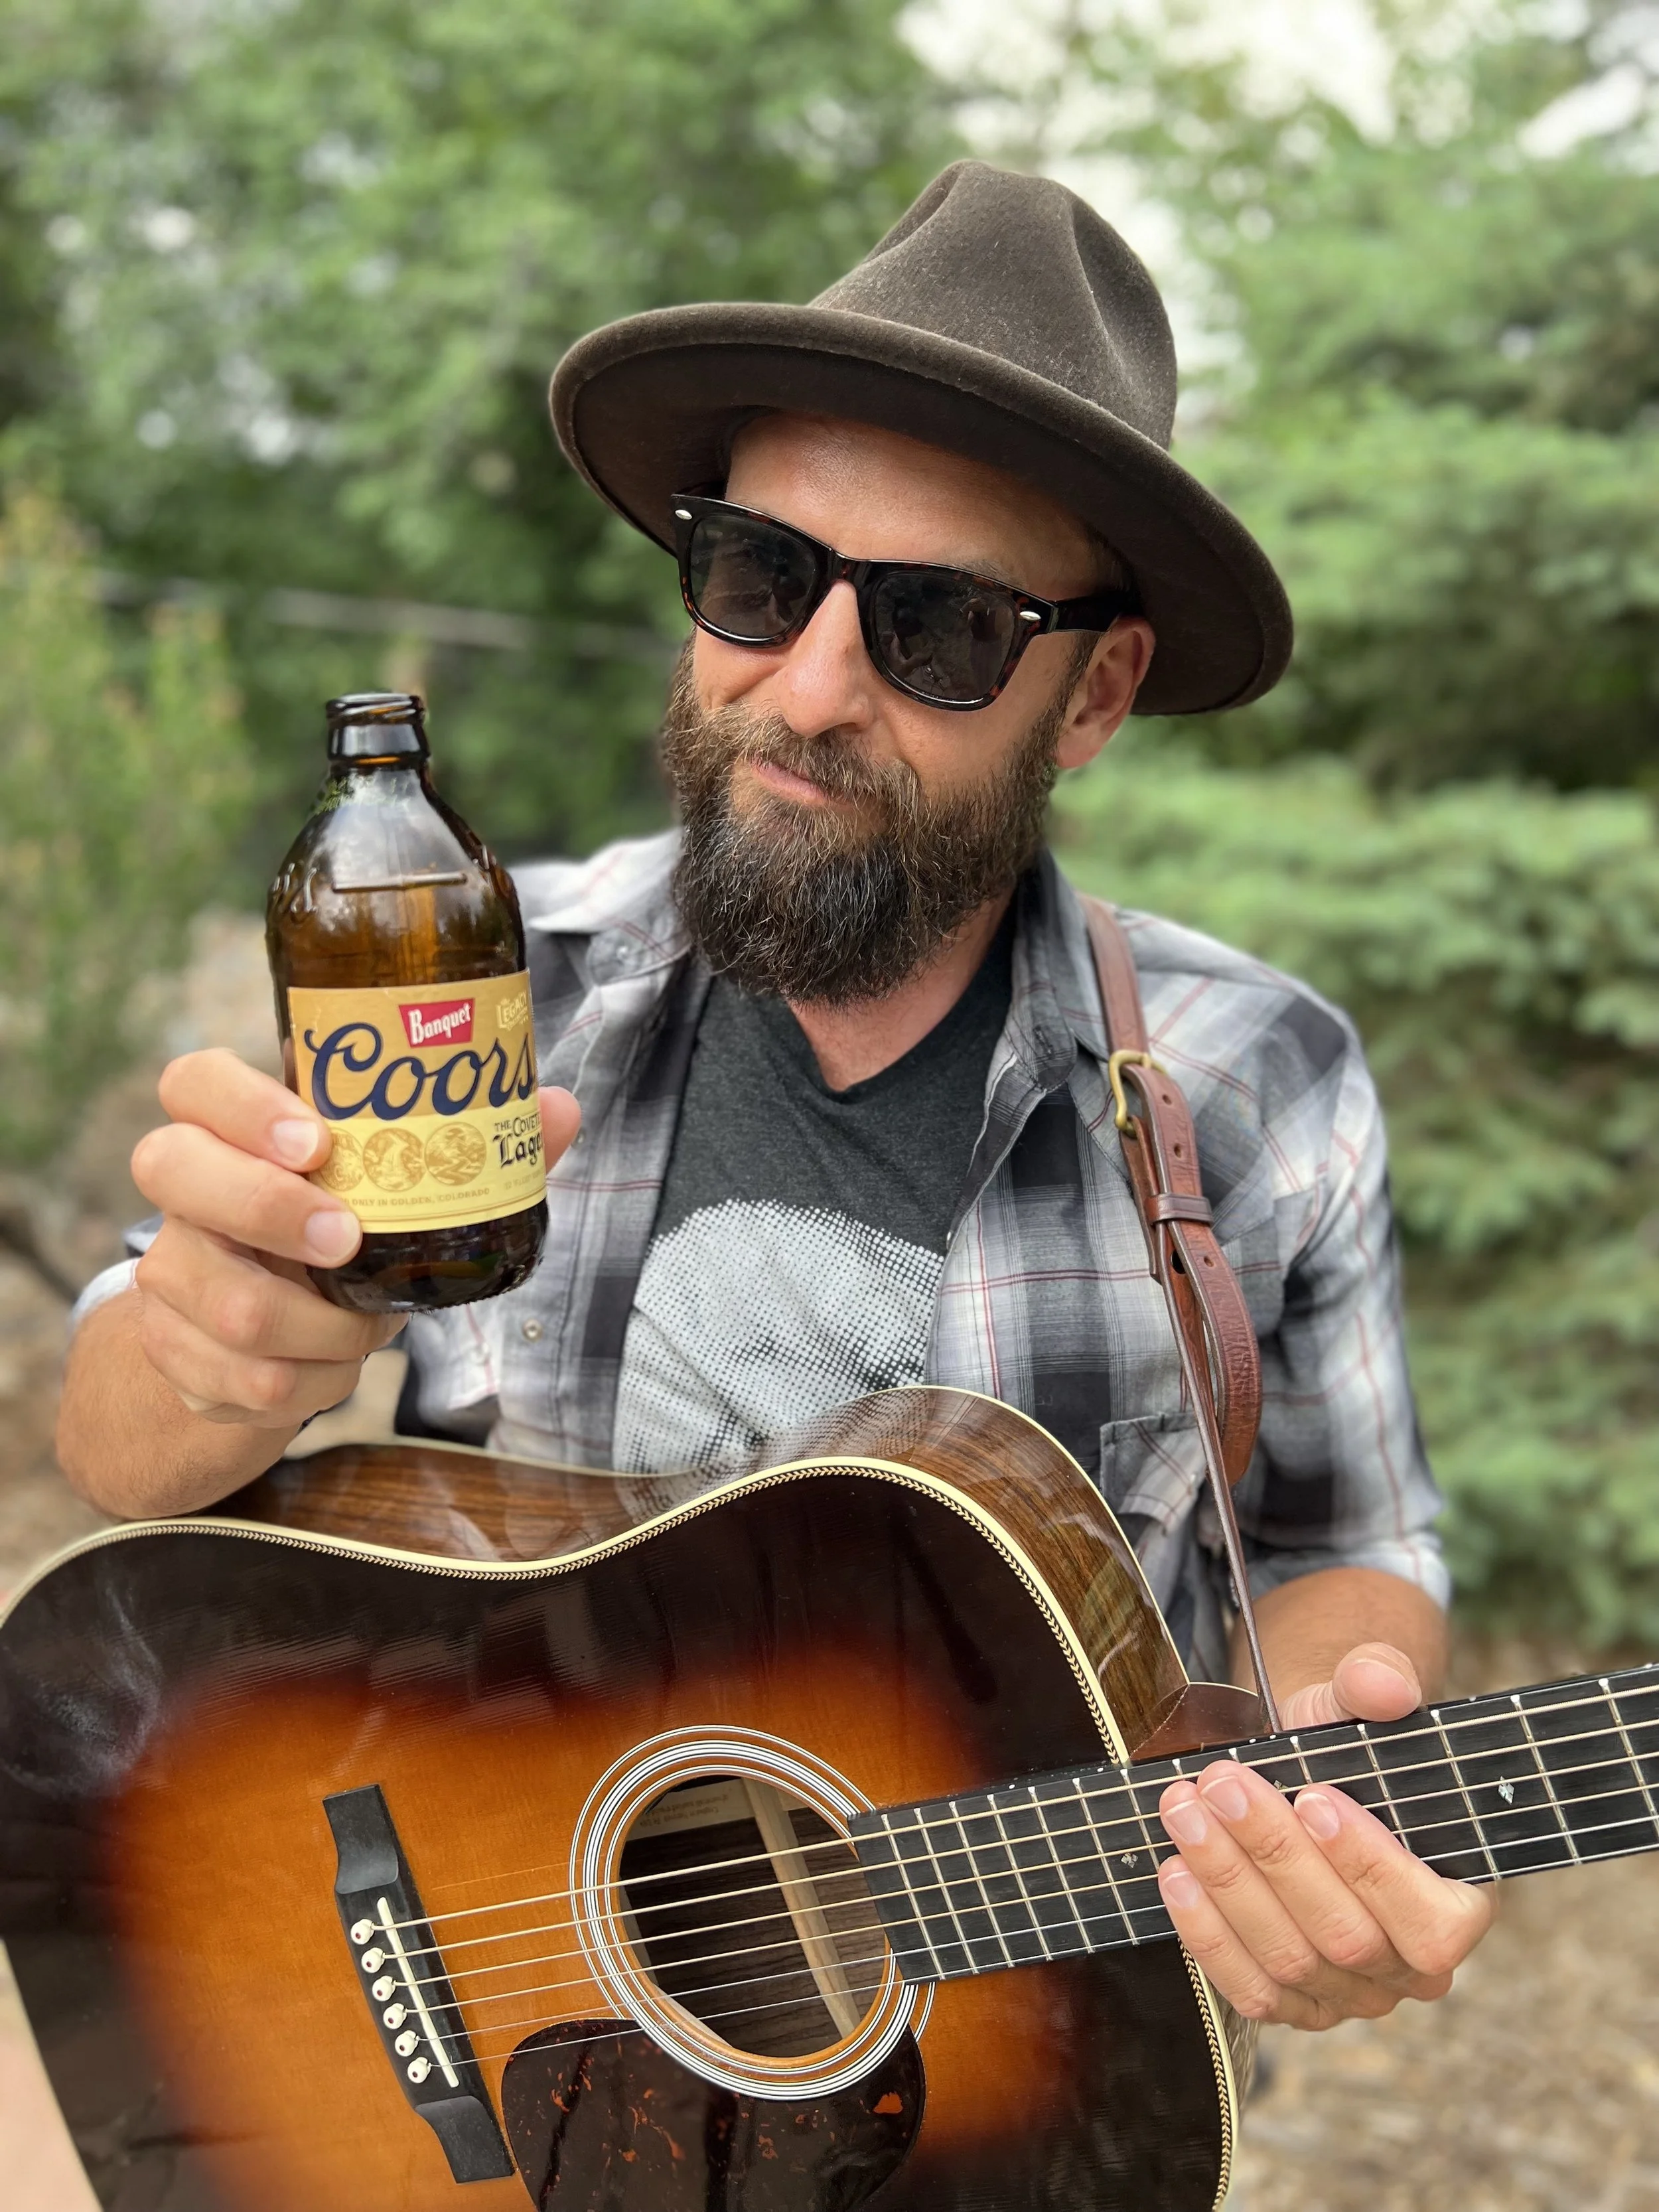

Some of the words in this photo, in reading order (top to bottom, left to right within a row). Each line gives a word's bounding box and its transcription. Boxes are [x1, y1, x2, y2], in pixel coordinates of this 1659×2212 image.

[408, 1003, 472, 1045] Banquet
[304, 1022, 534, 1121] Coors
[494, 1120, 512, 1132] THE
[493, 1131, 543, 1169] Lage
[352, 1198, 375, 1207] ONLY
[439, 1187, 490, 1202] COLORADO
